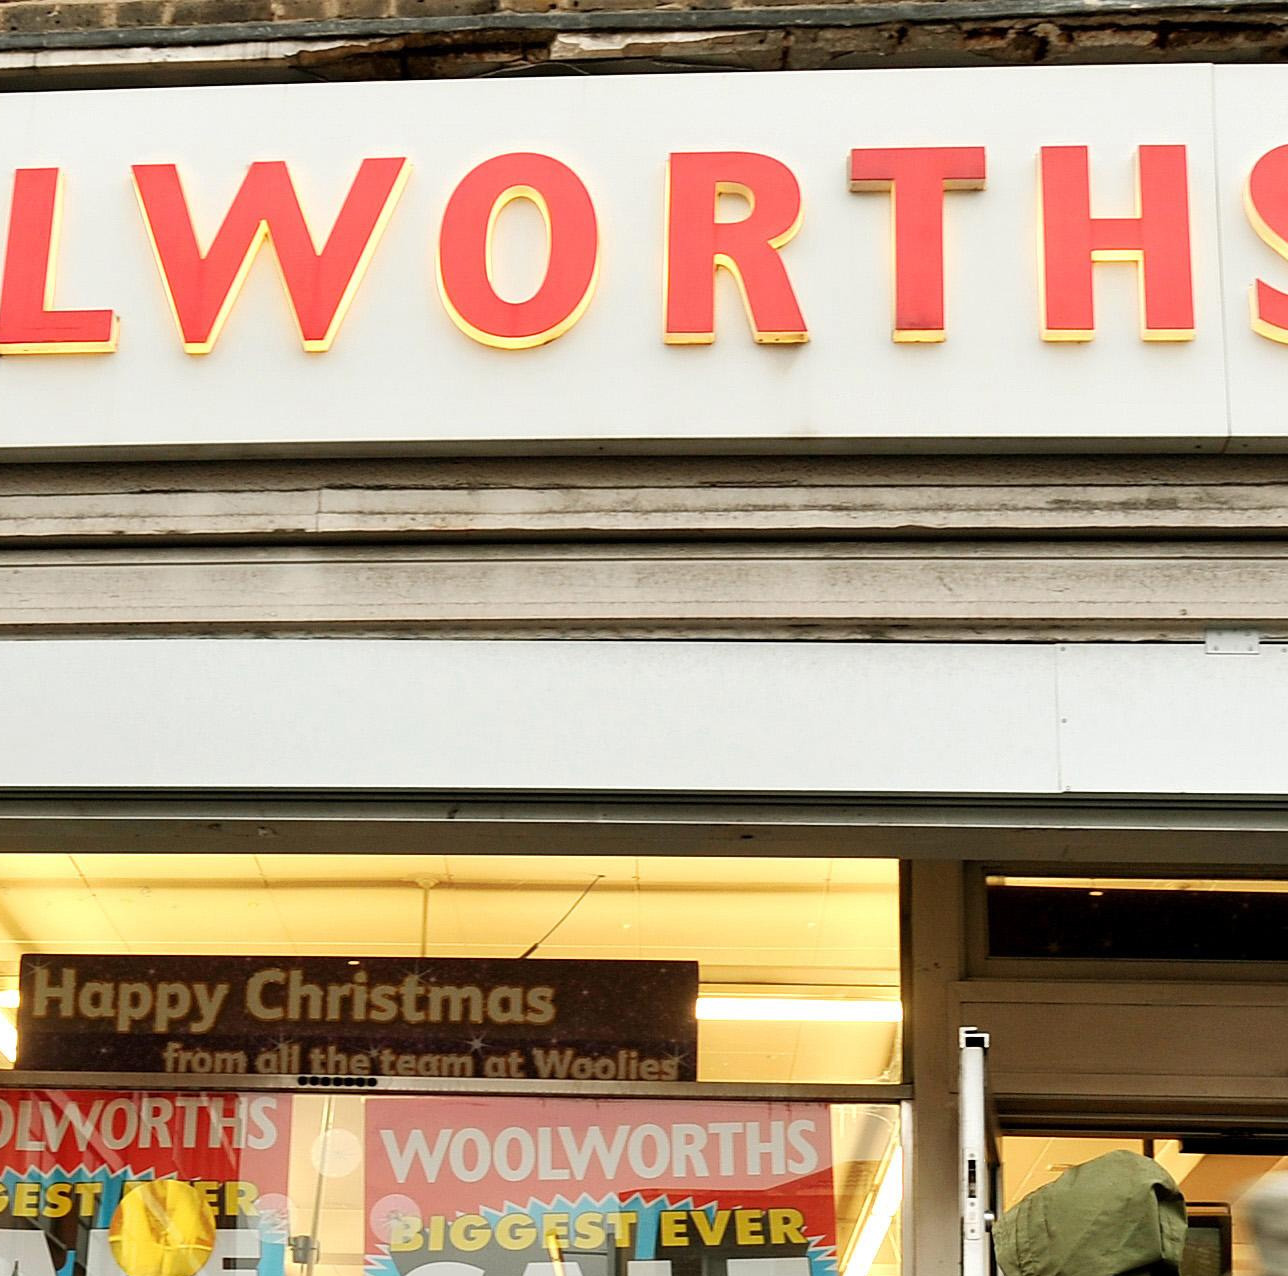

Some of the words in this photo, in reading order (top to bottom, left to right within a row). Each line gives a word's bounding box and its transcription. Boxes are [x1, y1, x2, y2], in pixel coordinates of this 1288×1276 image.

[31, 966, 230, 1033] Happy
[245, 967, 556, 1025] Christmas
[164, 1041, 247, 1075] from
[255, 1043, 300, 1076] all
[311, 1045, 370, 1077] the
[378, 1049, 474, 1078] team
[483, 1049, 524, 1079] at
[533, 1047, 680, 1081] Woolies
[380, 1119, 819, 1183] WOOLWORTHS
[124, 1180, 260, 1217] ER
[388, 1210, 637, 1253] BIGGEST
[660, 1208, 807, 1248] EVER
